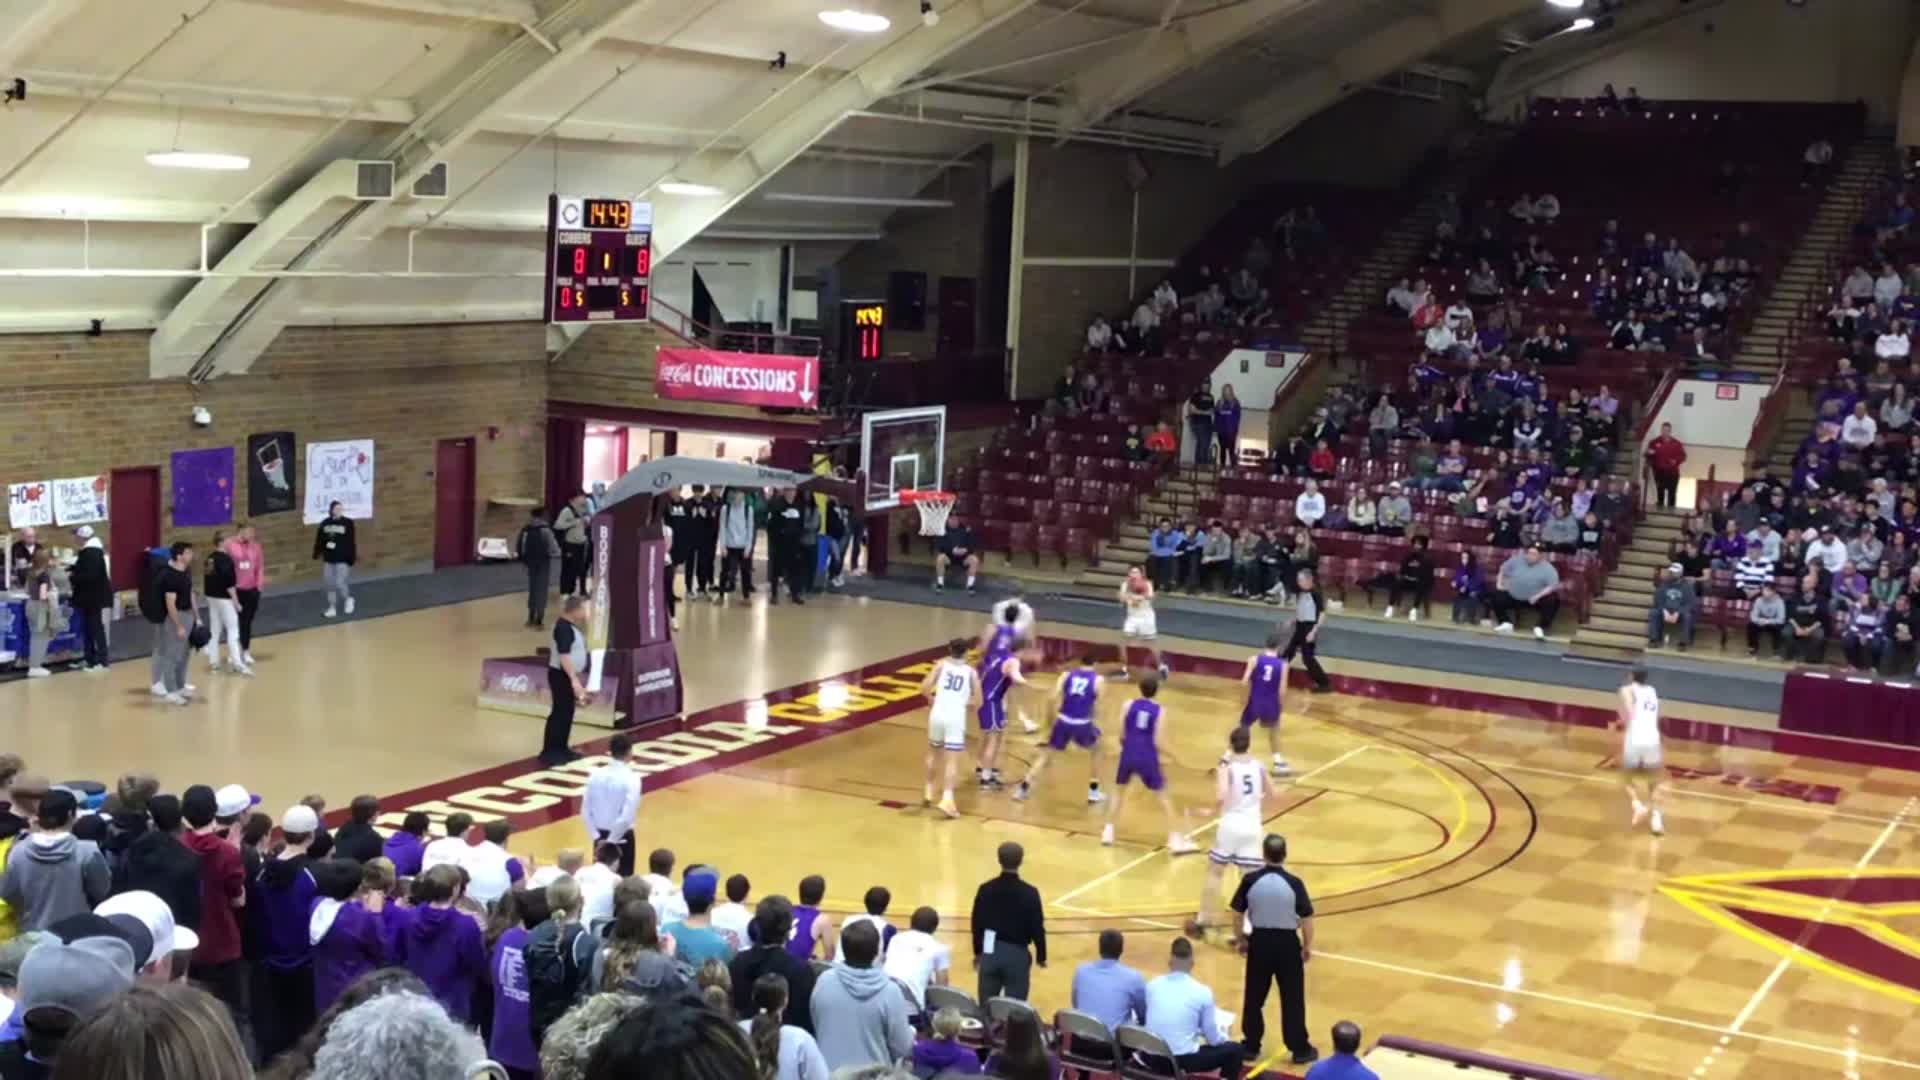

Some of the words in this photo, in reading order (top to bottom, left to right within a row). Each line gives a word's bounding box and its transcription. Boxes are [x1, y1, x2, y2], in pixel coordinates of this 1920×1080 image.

[574, 248, 586, 274] 8
[637, 249, 649, 274] 8
[560, 287, 571, 307] 0
[694, 364, 797, 393] CONCESSIONS
[943, 671, 964, 692] 30
[1242, 774, 1254, 796] 5
